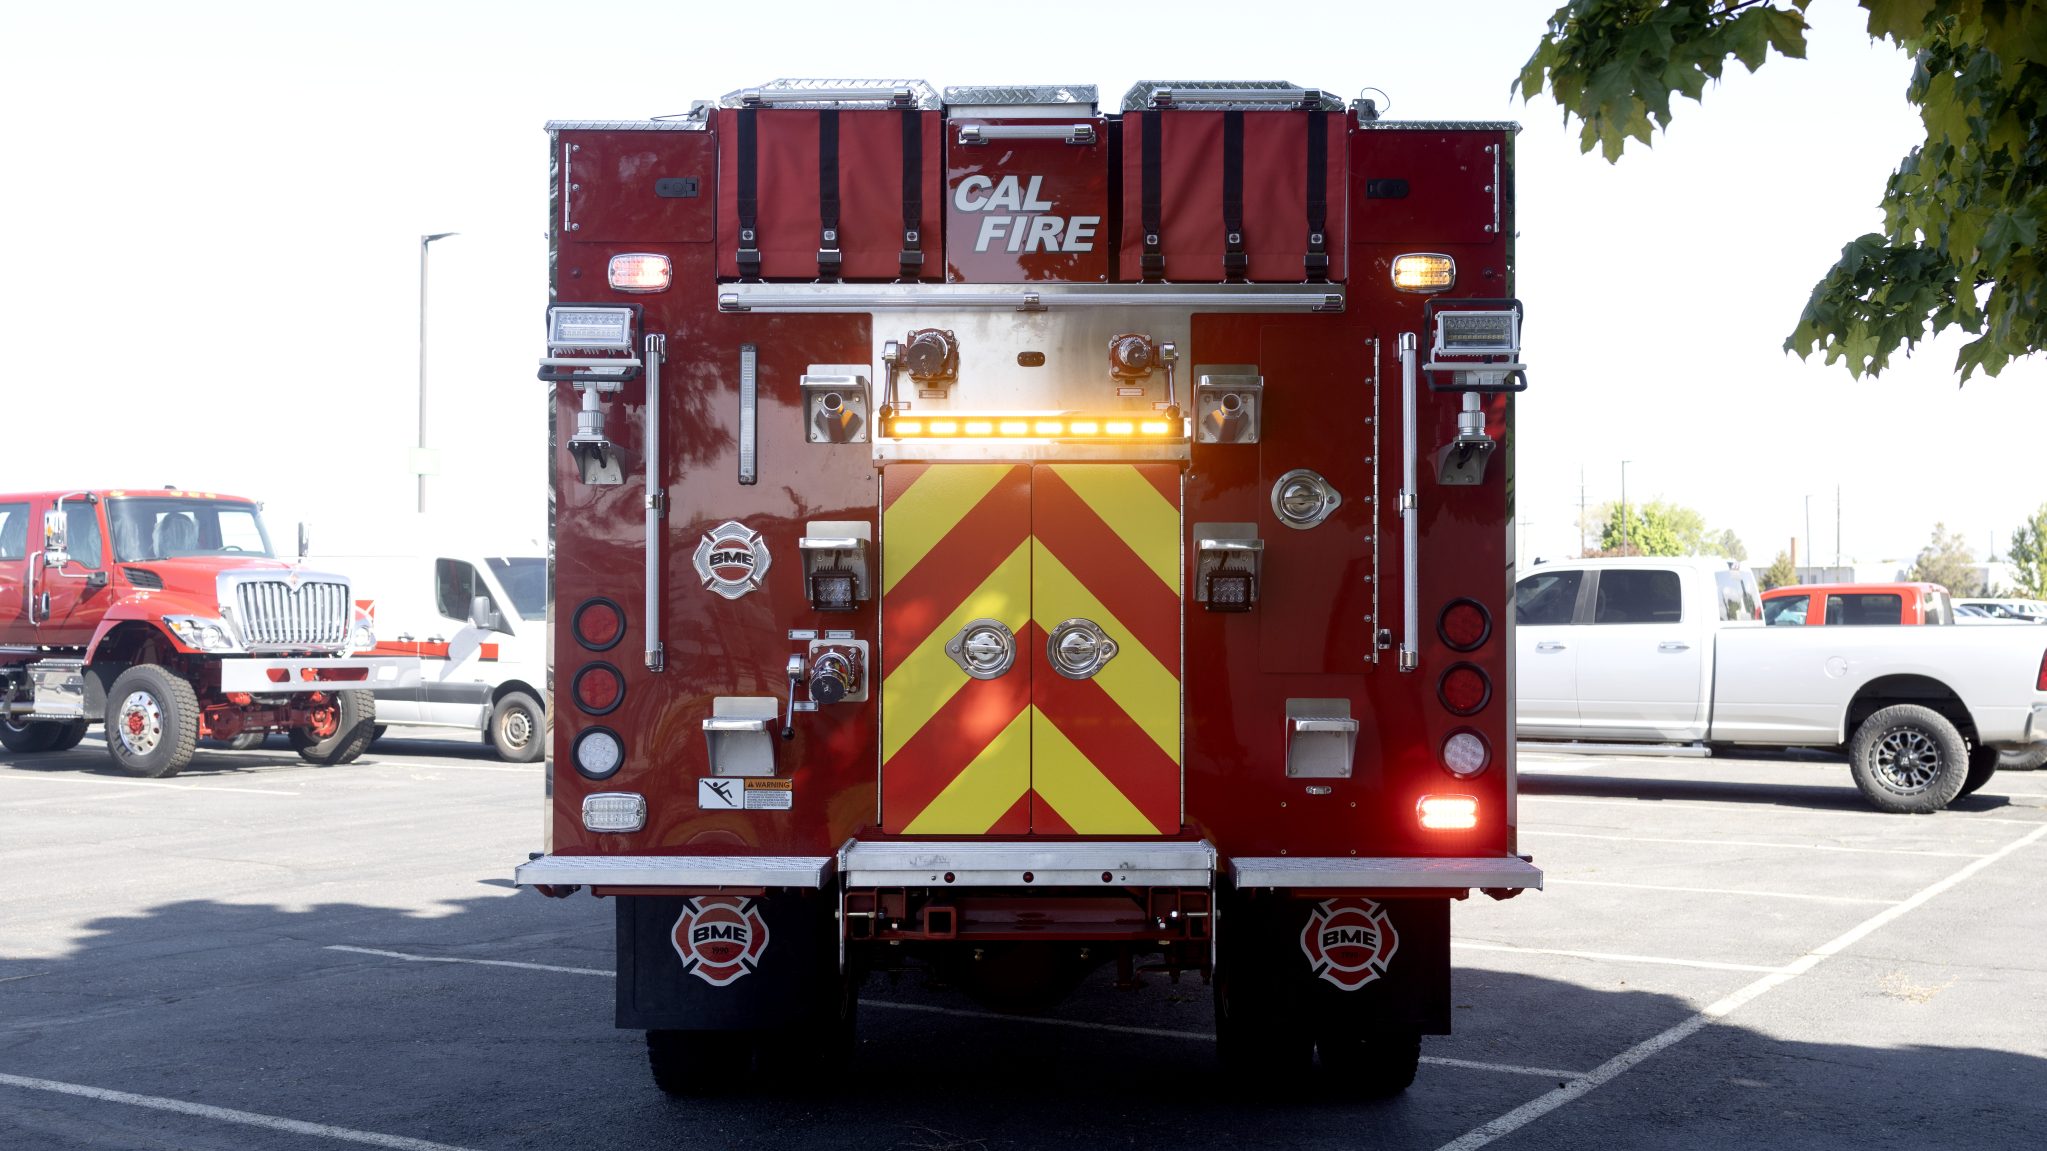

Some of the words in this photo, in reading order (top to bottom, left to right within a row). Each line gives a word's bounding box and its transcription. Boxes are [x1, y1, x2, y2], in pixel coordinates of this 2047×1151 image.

[954, 174, 1053, 212] CAL
[974, 215, 1101, 252] FIRE
[709, 551, 754, 567] BME
[693, 925, 748, 944] BME
[1322, 929, 1377, 948] BME
